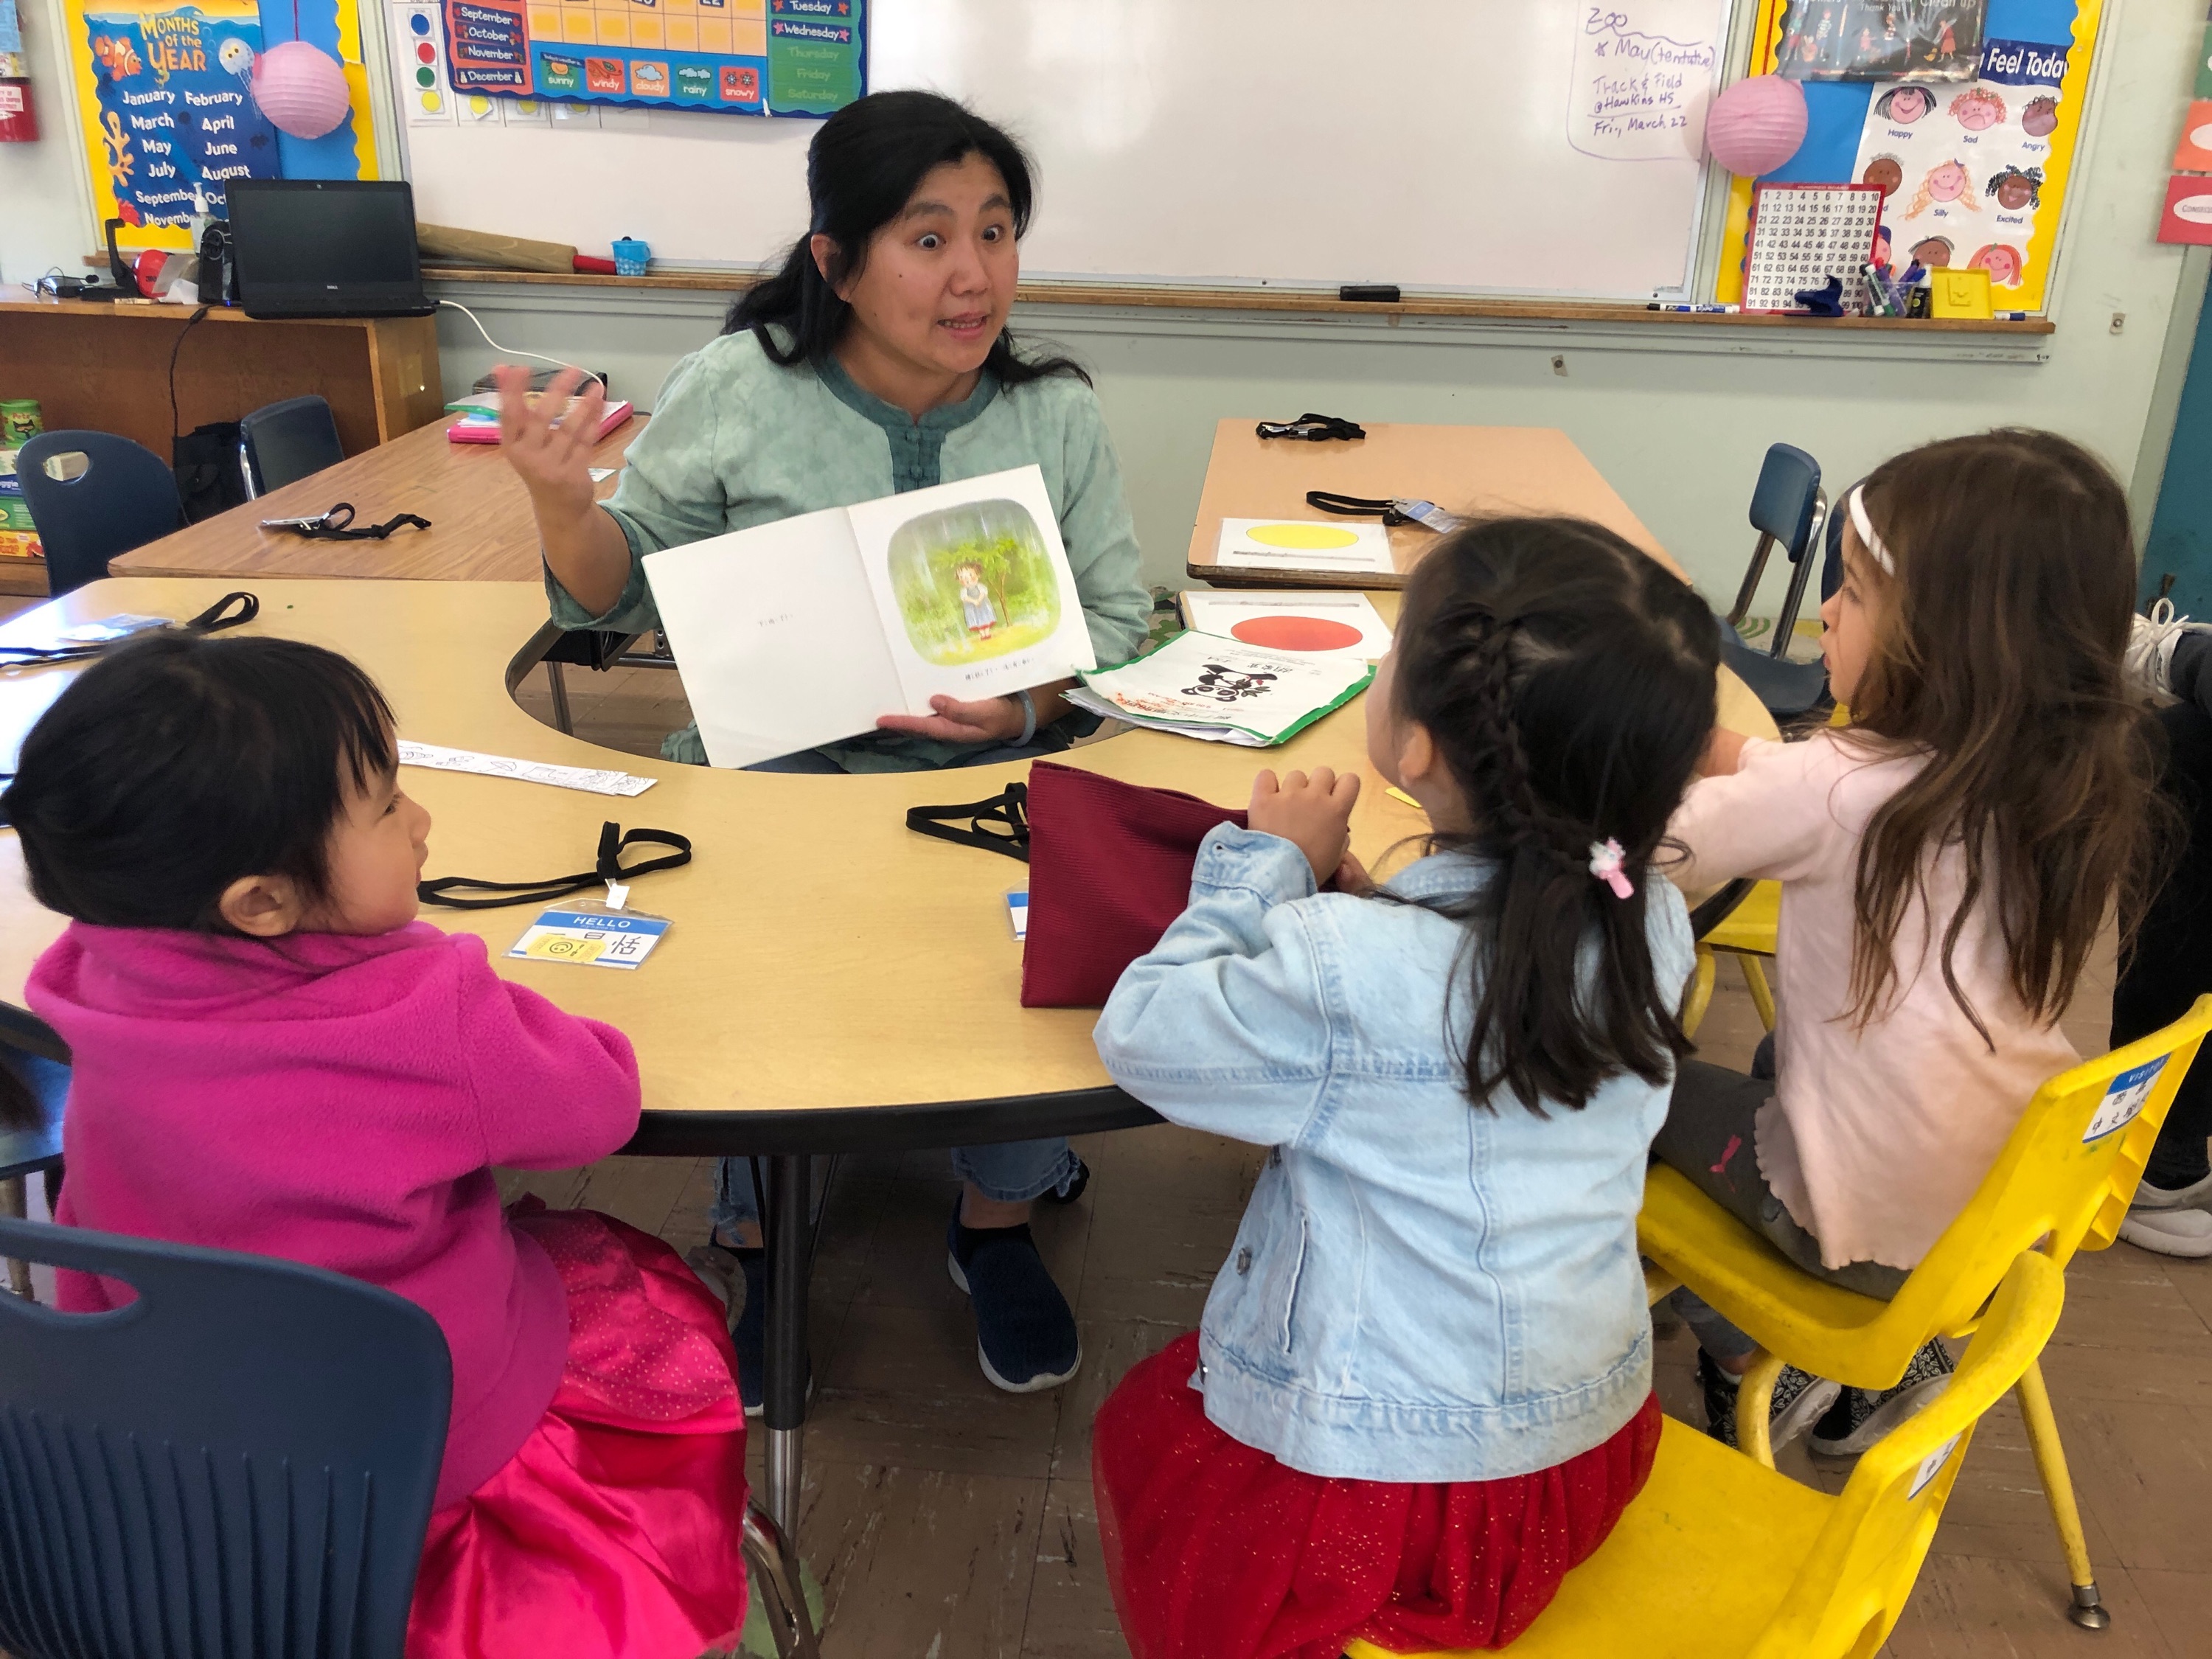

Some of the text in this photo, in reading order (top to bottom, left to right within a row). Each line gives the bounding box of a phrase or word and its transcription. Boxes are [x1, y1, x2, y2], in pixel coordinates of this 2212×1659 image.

[790, 0, 832, 14] Tuesday
[1860, 4, 1901, 12] Thank You
[461, 7, 512, 26] September
[139, 12, 200, 40] MONTHS
[784, 22, 839, 41] Wednesday
[468, 27, 509, 42] October
[181, 35, 202, 48] the
[147, 41, 206, 72] YEAR
[467, 46, 513, 60] November
[787, 46, 840, 60] Thursday
[1987, 48, 2024, 74] Feel
[467, 71, 513, 81] December
[796, 68, 831, 82] Friday
[1654, 72, 1682, 89] Field
[548, 76, 574, 88] sunny
[592, 78, 619, 91] windy
[636, 80, 665, 94] cloudy
[683, 85, 707, 97] rainy
[725, 88, 754, 99] snowy
[787, 88, 838, 102] Saturday
[122, 90, 243, 106] January February
[1659, 91, 1674, 105] HS
[131, 113, 234, 134] March April
[1627, 114, 1666, 131] March
[1671, 116, 1688, 127] 22
[1888, 129, 1913, 139] Happy
[1963, 136, 1978, 144] Sad
[142, 139, 238, 156] May June
[2022, 142, 2045, 151] Angry
[148, 161, 251, 181] July August
[1776, 191, 1781, 199] 2
[1789, 191, 1793, 200] 3
[1800, 191, 1806, 200] 4
[1813, 191, 1818, 200] 5
[1826, 192, 1830, 200] 6
[1838, 192, 1843, 200] 7
[1850, 192, 1855, 201] 8
[1861, 193, 1866, 201] 9
[1871, 192, 1879, 201] 10
[1773, 203, 1781, 212] 12
[1785, 204, 1793, 212] 13
[1797, 204, 1806, 212] 14
[1810, 204, 1818, 212] 15
[1822, 204, 1830, 213] 16
[1847, 204, 1855, 213] 18
[1859, 205, 1866, 213] 19
[1868, 205, 1877, 213] 20
[1933, 209, 1949, 218] Silly
[1758, 215, 1874, 226] 21 22 23 24 25 26 27 28 29 30
[1996, 215, 2023, 224] Excited
[1757, 227, 1873, 238] 31 32 33 34 35 36 37 38 39 40
[1767, 240, 1776, 248] 42
[1779, 240, 1788, 248] 43
[1803, 240, 1813, 249] 45
[1816, 241, 1825, 249] 46
[1828, 241, 1837, 249] 47
[1840, 241, 1849, 250] 48
[1851, 241, 1860, 250] 49
[1863, 241, 1870, 250] 50
[1766, 252, 1774, 260] 52
[1778, 252, 1786, 260] 53
[1789, 252, 1799, 260] 54
[1802, 253, 1811, 261] 55
[1814, 253, 1823, 261] 56
[1826, 253, 1836, 261] 57
[1838, 253, 1847, 261] 58
[1849, 253, 1858, 262] 59
[1860, 254, 1868, 262] 60
[1764, 263, 1773, 272] 62
[1776, 264, 1785, 272] 63
[1788, 264, 1797, 272] 64
[1800, 264, 1809, 273] 65
[1812, 265, 1821, 273] 66
[1824, 265, 1833, 273] 67
[1836, 265, 1844, 273] 68
[1848, 265, 1856, 274] 69
[1763, 275, 1771, 284] 72
[1775, 276, 1783, 284] 73
[1787, 276, 1795, 284] 74
[1799, 276, 1807, 284] 75
[1811, 277, 1819, 285] 76
[1761, 287, 1770, 295] 82
[1772, 288, 1781, 296] 83
[1784, 288, 1793, 296] 84
[573, 916, 631, 928] HELLO
